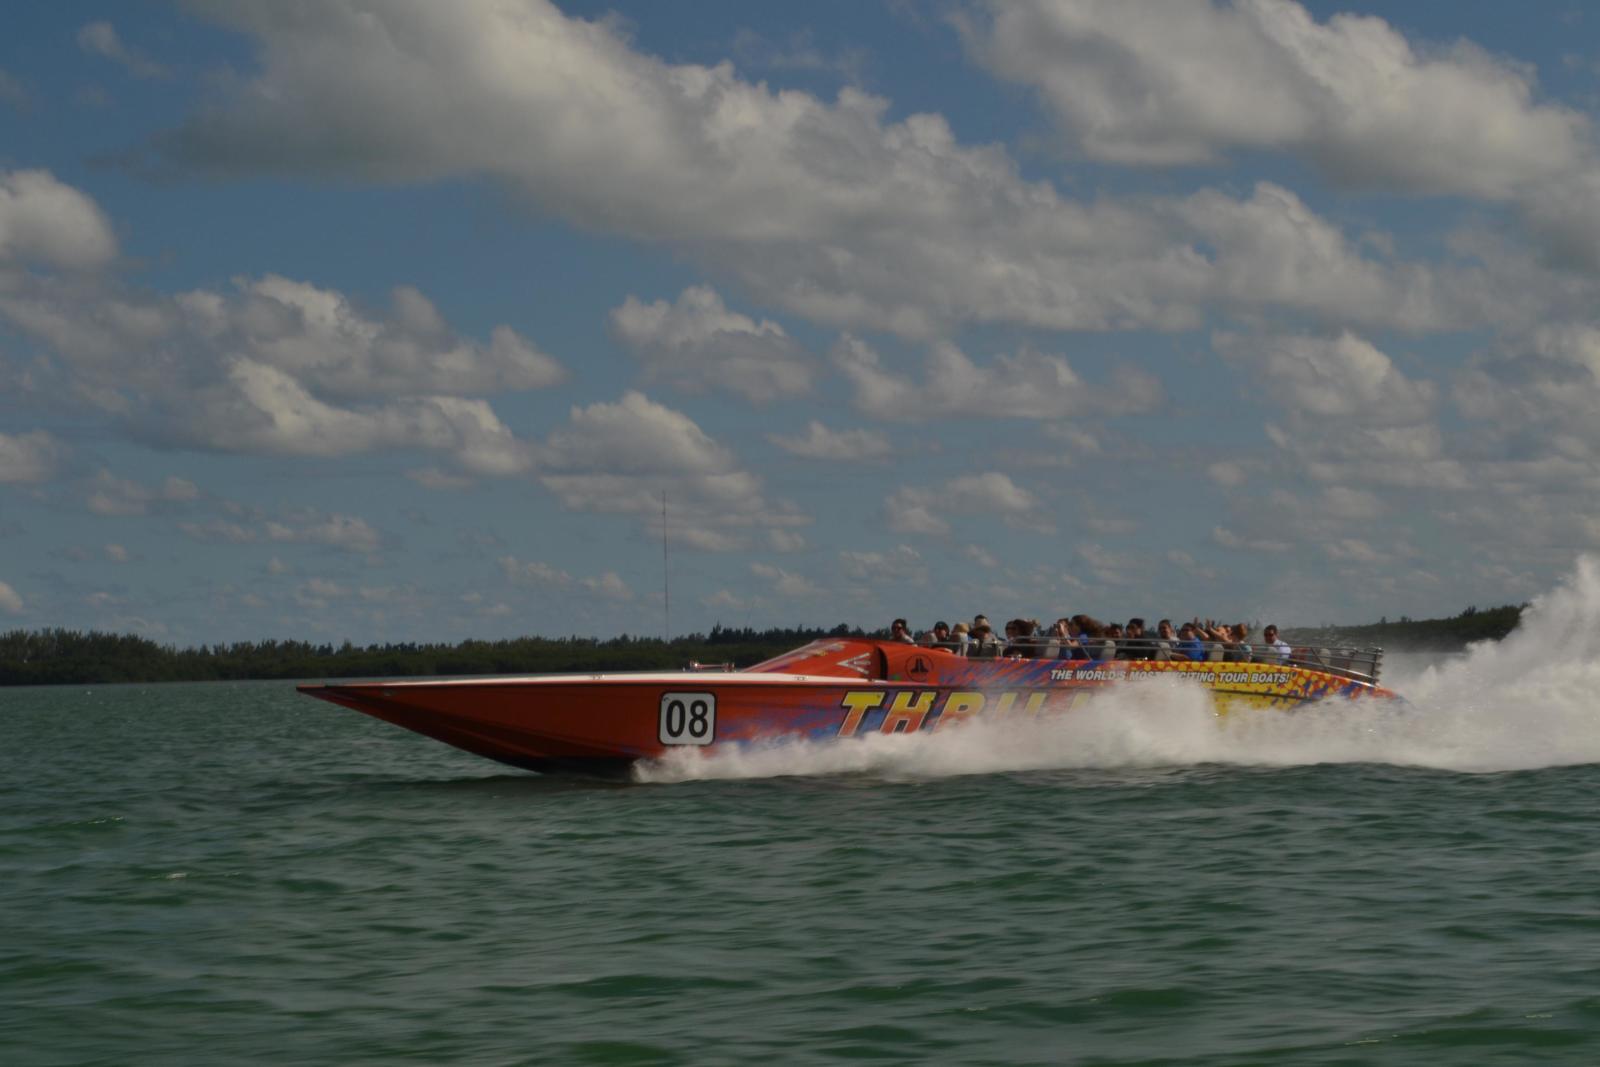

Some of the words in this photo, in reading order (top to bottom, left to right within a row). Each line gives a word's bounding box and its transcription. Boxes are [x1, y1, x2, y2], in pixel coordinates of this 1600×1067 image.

[1051, 670, 1073, 680] THE
[1168, 671, 1215, 682] CITING
[1219, 672, 1249, 683] TOUR
[1251, 673, 1290, 683] BOATS!
[666, 700, 708, 738] 08
[838, 691, 1092, 738] THRI
